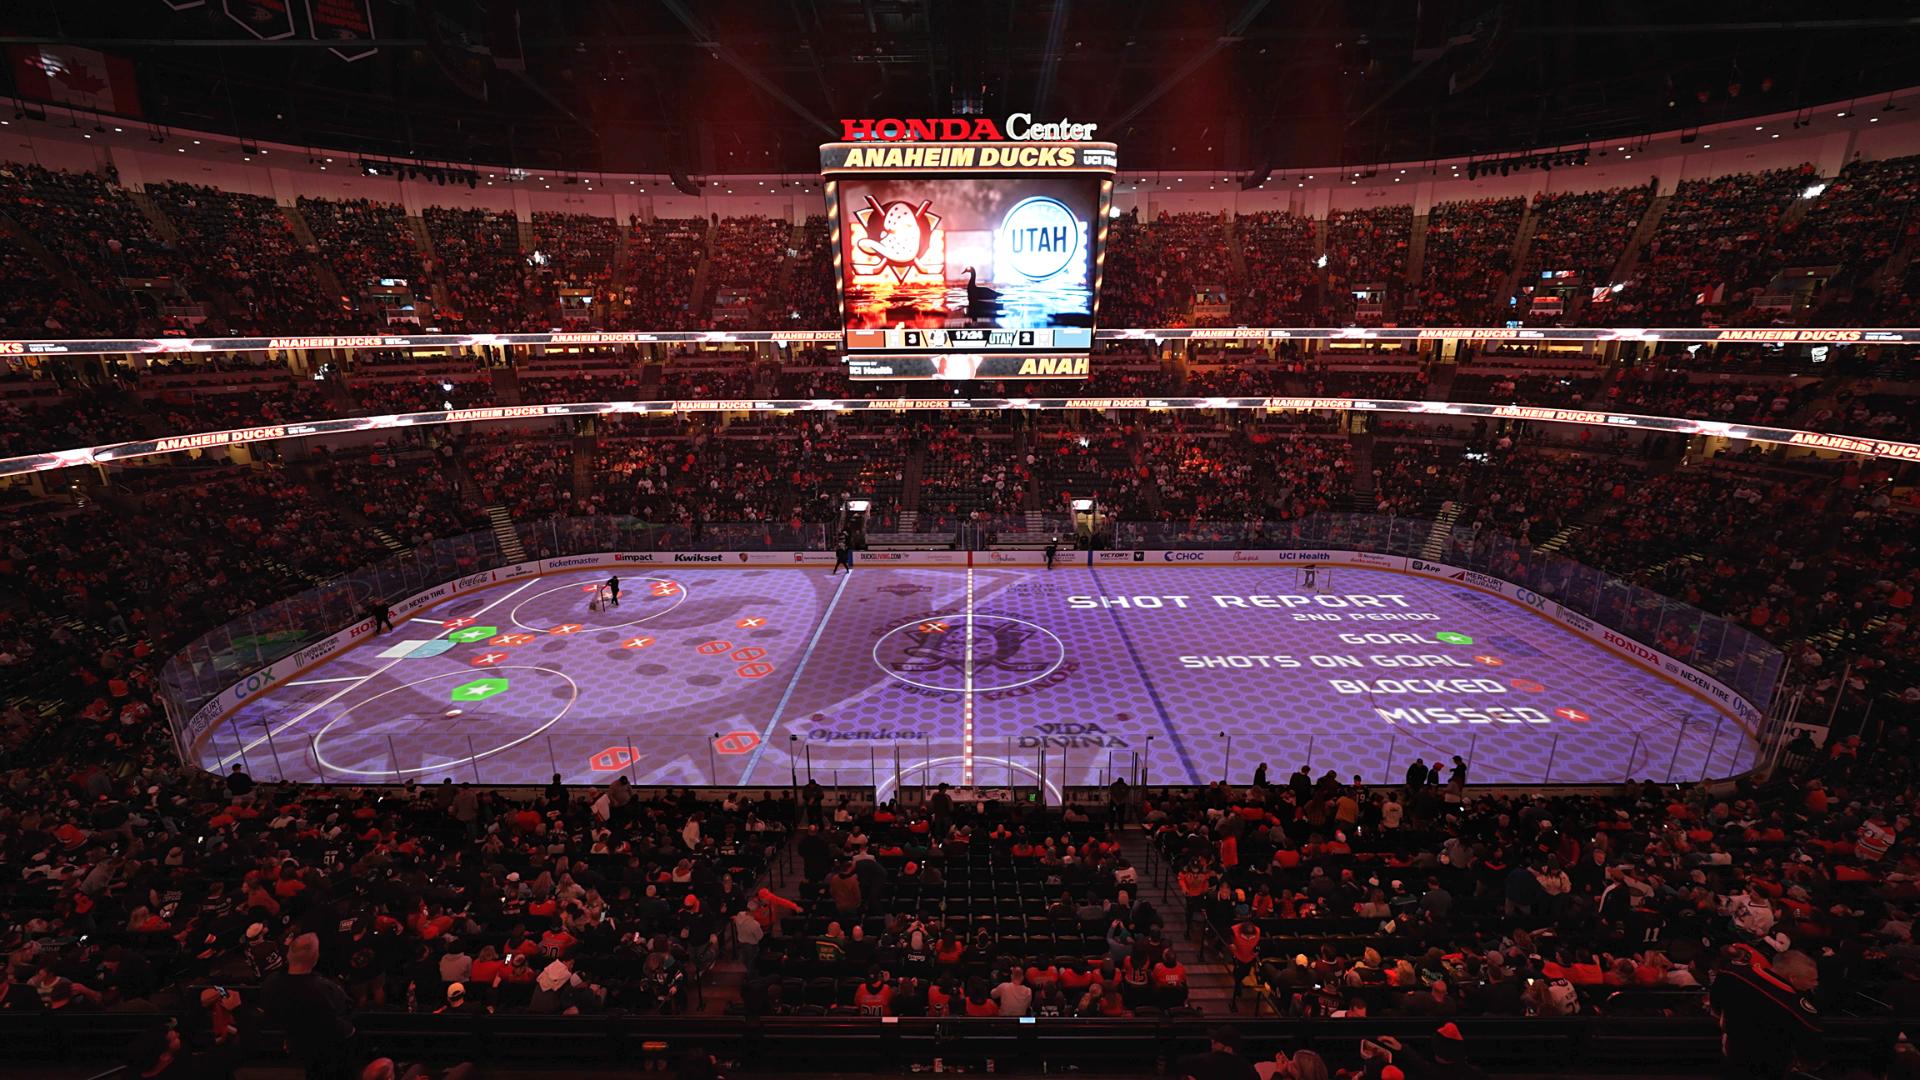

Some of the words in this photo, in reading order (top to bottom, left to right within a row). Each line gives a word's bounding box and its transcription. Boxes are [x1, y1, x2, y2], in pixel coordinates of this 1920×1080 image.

[840, 118, 1004, 141] HONDA
[1006, 113, 1097, 141] Center
[844, 148, 976, 167] ANAHEIM
[979, 148, 1075, 167] DUCKS
[1012, 226, 1067, 253] UTAH
[550, 334, 600, 343] ANAHEIM
[600, 333, 636, 342] DUCKS
[771, 332, 814, 340] ANAHEIM
[988, 332, 1014, 345] UTAH
[1190, 330, 1235, 338] ANAHEIM
[1419, 329, 1474, 338] ANAHEIM
[1474, 329, 1517, 338] DUCKS
[1717, 330, 1800, 341] ANAHEIM
[1800, 330, 1861, 341] DUCKS
[268, 338, 335, 348] ANAHEIM
[336, 337, 382, 347] DUCKS
[719, 401, 753, 410] DUCKS
[915, 400, 949, 409] DUCKS
[1065, 399, 1112, 408] ANAHEIM
[1112, 399, 1147, 408] DUCKS
[1314, 400, 1352, 409] DUCKS
[446, 409, 503, 421] ANAHEIM
[503, 406, 545, 416] DUCKS
[1492, 407, 1556, 419] ANAHEIM
[1556, 410, 1605, 423] DUCKS
[155, 432, 230, 450] ANAHEIM
[232, 427, 284, 444] DUCKS
[1788, 433, 1874, 452] ANAHEIM
[622, 554, 653, 562] impact
[674, 553, 723, 562] Kwikset
[1176, 552, 1205, 561] CHOC
[1279, 552, 1297, 560] UCI
[1299, 552, 1330, 560] Health
[549, 557, 599, 569] ticketmaster
[458, 573, 488, 589] Coca-Cola
[1466, 571, 1504, 587] MERCURY
[408, 594, 430, 609] NEXEN
[430, 588, 446, 599] TIRE
[1067, 595, 1190, 609] SHOT
[1211, 595, 1410, 608] REPORT
[1516, 588, 1546, 611] COX
[1290, 612, 1342, 621] 2ND
[1348, 612, 1441, 621] PERIOD
[350, 609, 398, 639] HONA
[1338, 633, 1440, 644] GOAL
[1602, 629, 1660, 667] HONDA
[1179, 655, 1302, 668] SHOTS
[1309, 655, 1364, 667] ON
[1370, 655, 1473, 667] GOAL
[234, 667, 276, 700] COX
[1328, 679, 1507, 693] BLOCKED
[1680, 669, 1710, 691] NEXEN
[1710, 684, 1730, 703] TIRE
[1375, 708, 1551, 723] MISSED
[1033, 722, 1108, 735] VIDA
[808, 728, 928, 743] Opendoor
[1018, 735, 1129, 748] DIVINA
